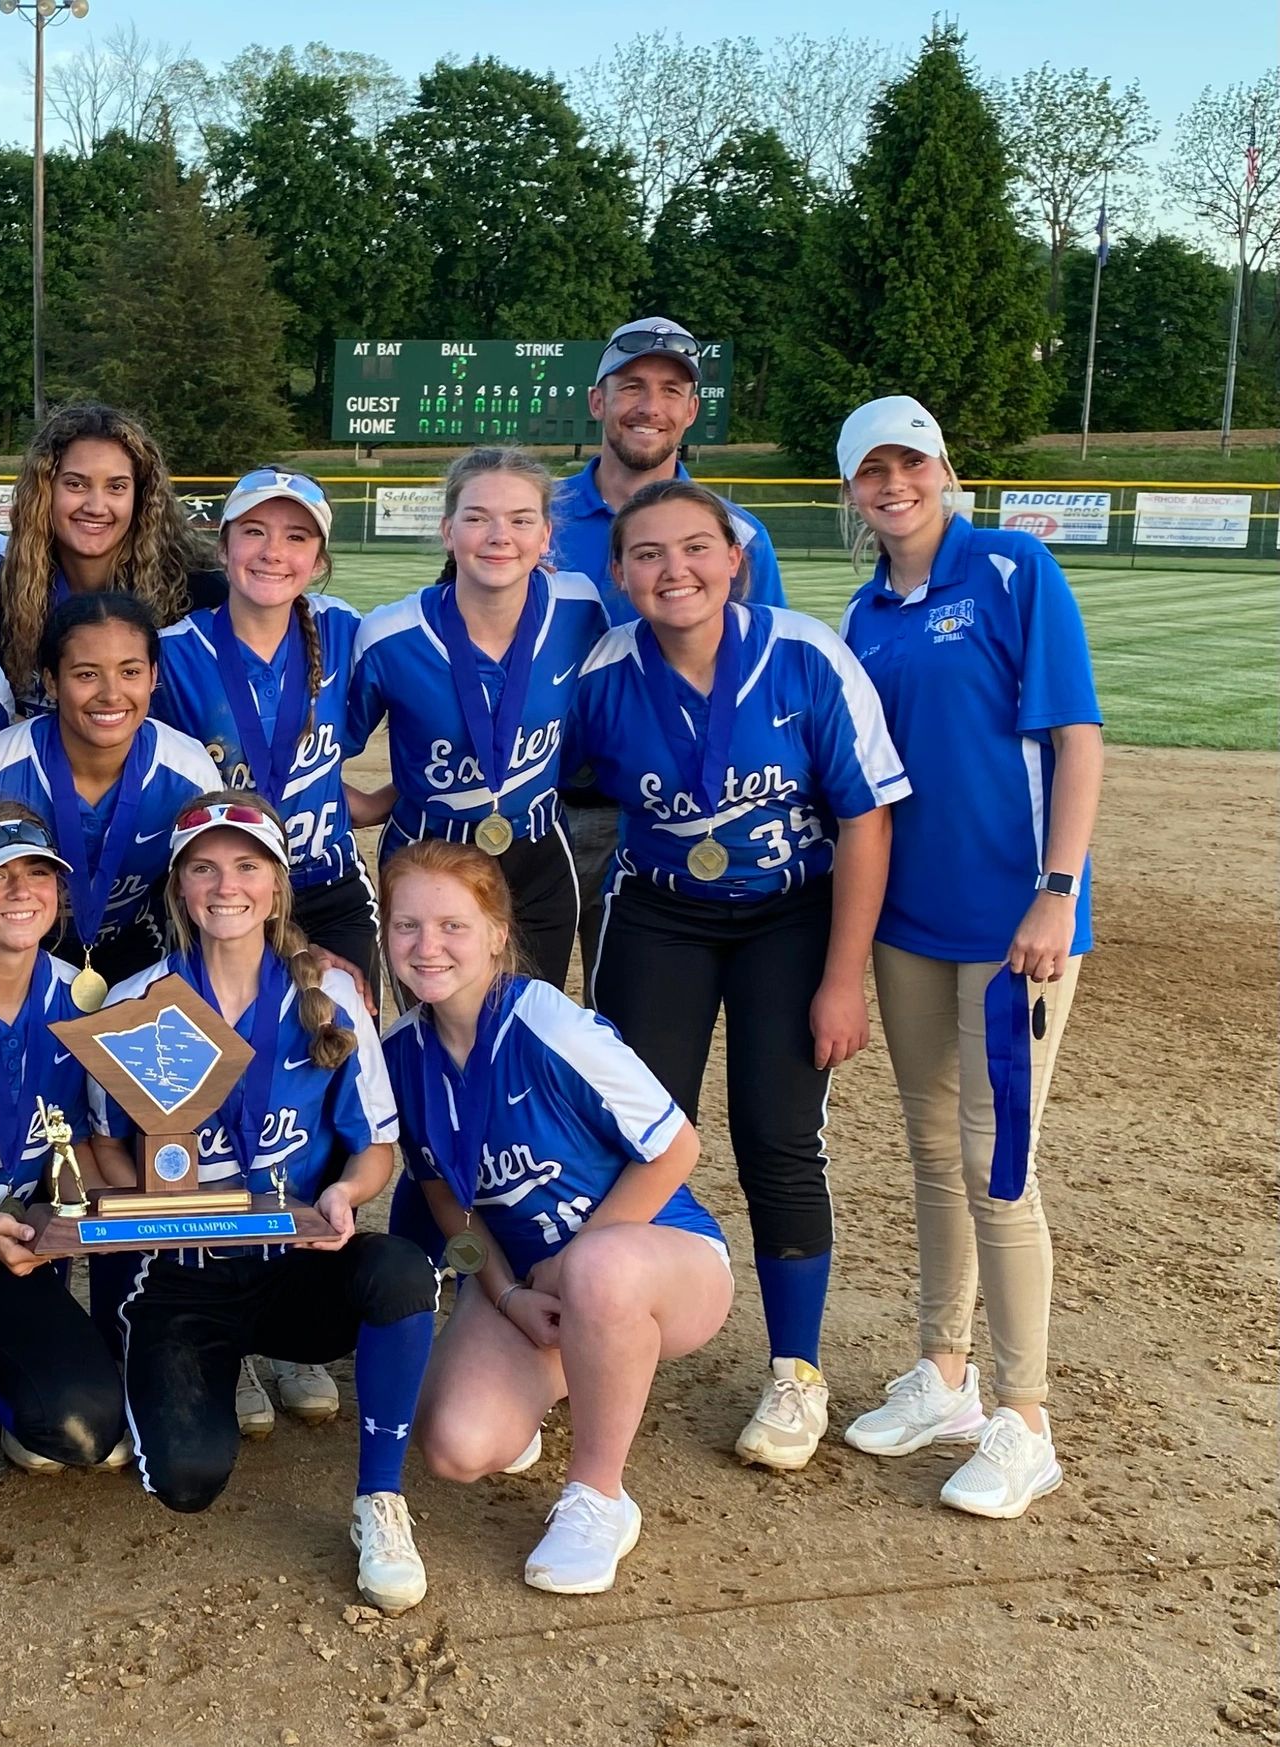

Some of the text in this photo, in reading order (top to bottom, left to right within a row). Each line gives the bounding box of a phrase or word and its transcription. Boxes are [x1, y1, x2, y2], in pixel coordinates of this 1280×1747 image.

[353, 343, 403, 356] AT BAT
[441, 343, 477, 356] BALL
[515, 343, 564, 357] STRIKE
[438, 385, 447, 396] 2
[454, 385, 464, 396] 3
[476, 385, 487, 396] 4
[493, 385, 503, 397] 5
[509, 385, 519, 397] 6
[533, 385, 542, 397] 7
[549, 386, 558, 397] 8
[566, 386, 576, 397] 9
[700, 387, 726, 398] ERR
[346, 397, 400, 412] GUEST
[348, 418, 396, 434] HOME
[1004, 493, 1109, 507] RADCLIFFE
[1153, 496, 1189, 504] RHODE
[1015, 516, 1049, 535] IGA
[927, 598, 975, 626] EXETER
[424, 719, 561, 790] Exter
[639, 765, 798, 820] Exter
[95, 1219, 279, 1237] 20 COUNTY CHAMPION 22
